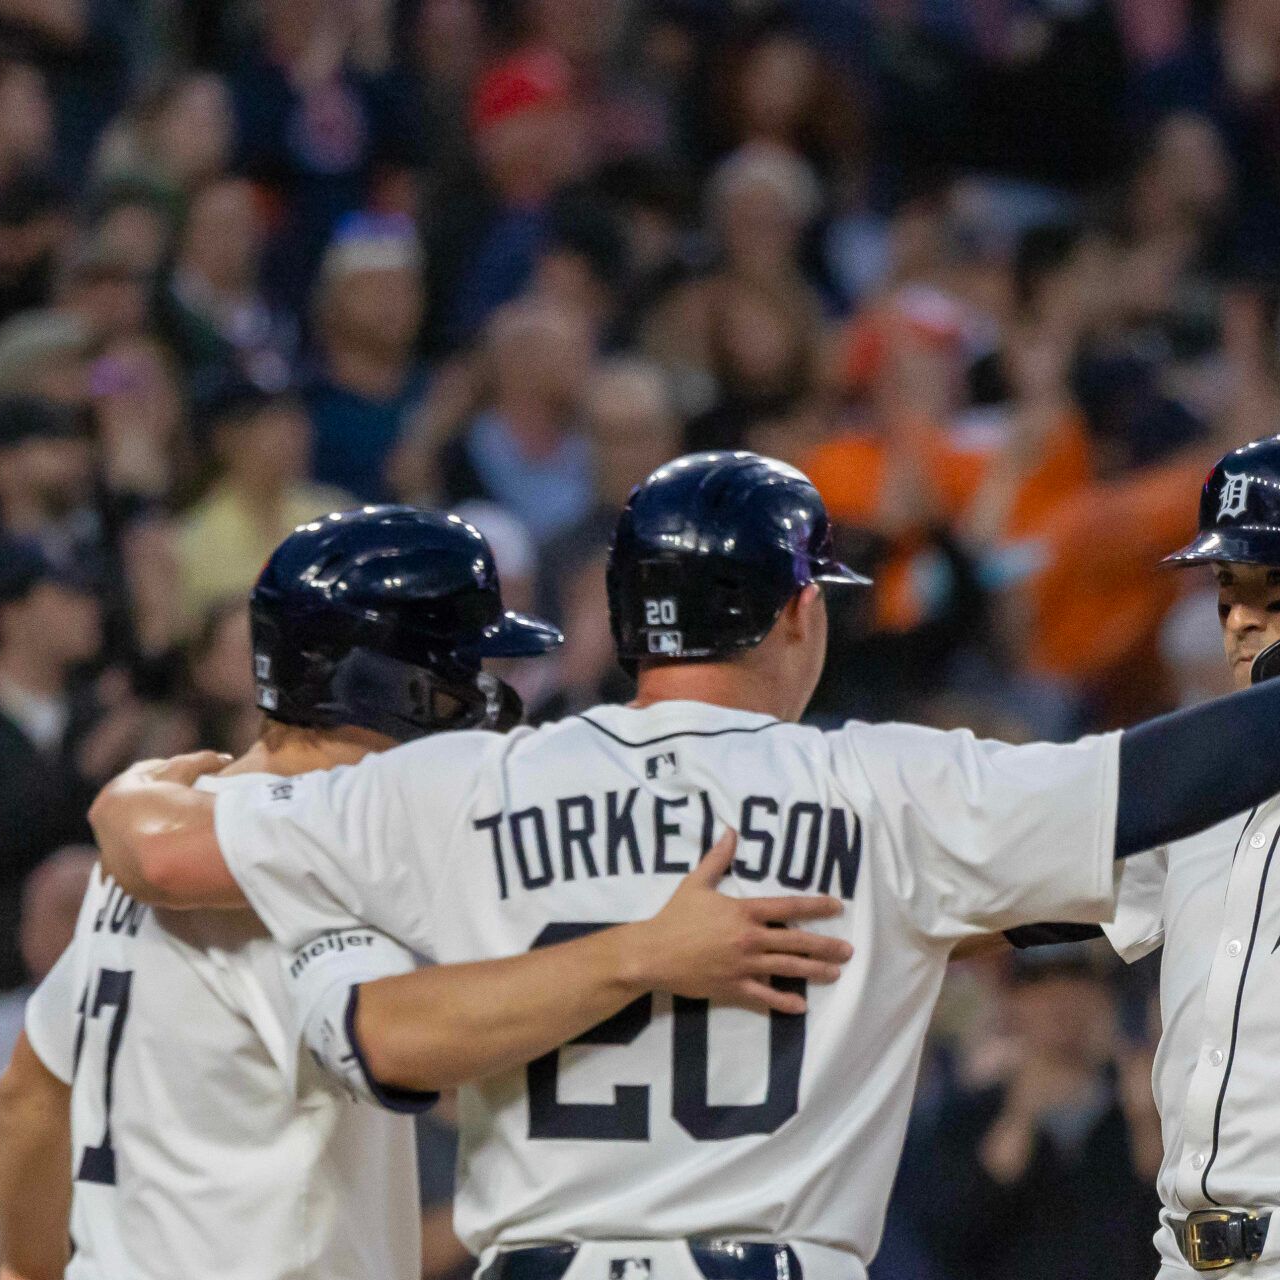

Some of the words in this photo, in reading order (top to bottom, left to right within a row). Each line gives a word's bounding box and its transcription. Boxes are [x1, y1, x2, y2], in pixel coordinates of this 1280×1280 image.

[1216, 469, 1248, 523] D
[645, 599, 677, 625] 20
[473, 786, 862, 901] TORKELSON
[289, 934, 375, 979] meijer
[526, 922, 808, 1142] 20
